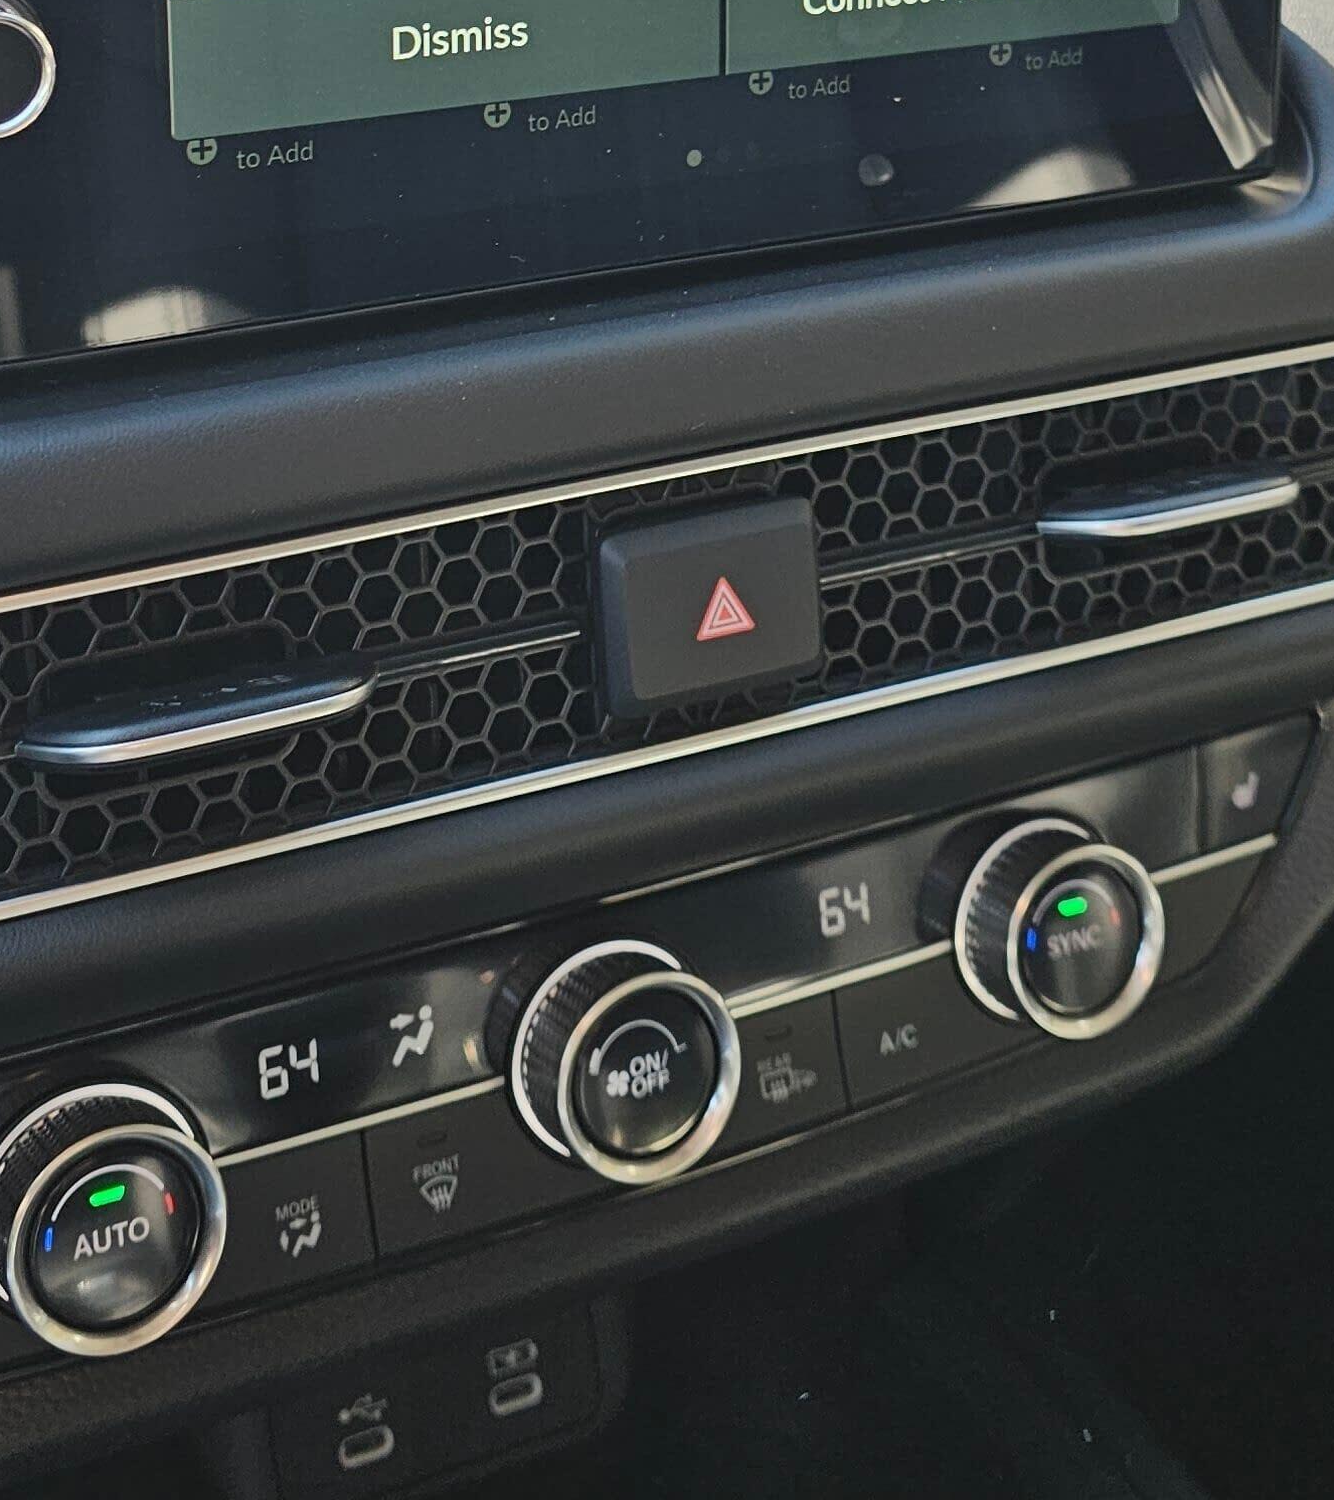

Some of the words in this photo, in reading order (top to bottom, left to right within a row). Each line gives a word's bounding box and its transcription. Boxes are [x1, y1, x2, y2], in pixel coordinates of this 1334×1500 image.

[392, 16, 529, 61] Dismiss
[1024, 53, 1043, 71] to
[1047, 47, 1084, 69] Add
[787, 82, 807, 100] to
[812, 75, 852, 98] Add
[527, 112, 550, 133] to
[554, 105, 597, 129] Add
[236, 150, 261, 170] to
[267, 140, 315, 167] Add
[818, 882, 871, 938] 64
[1046, 924, 1101, 959] SYNC
[879, 1023, 919, 1057] A/C
[258, 1038, 320, 1100] 64
[631, 1068, 671, 1099] OFF
[411, 1153, 460, 1183] FRONT
[275, 1195, 320, 1222] MODE
[73, 1215, 151, 1262] AUTO
